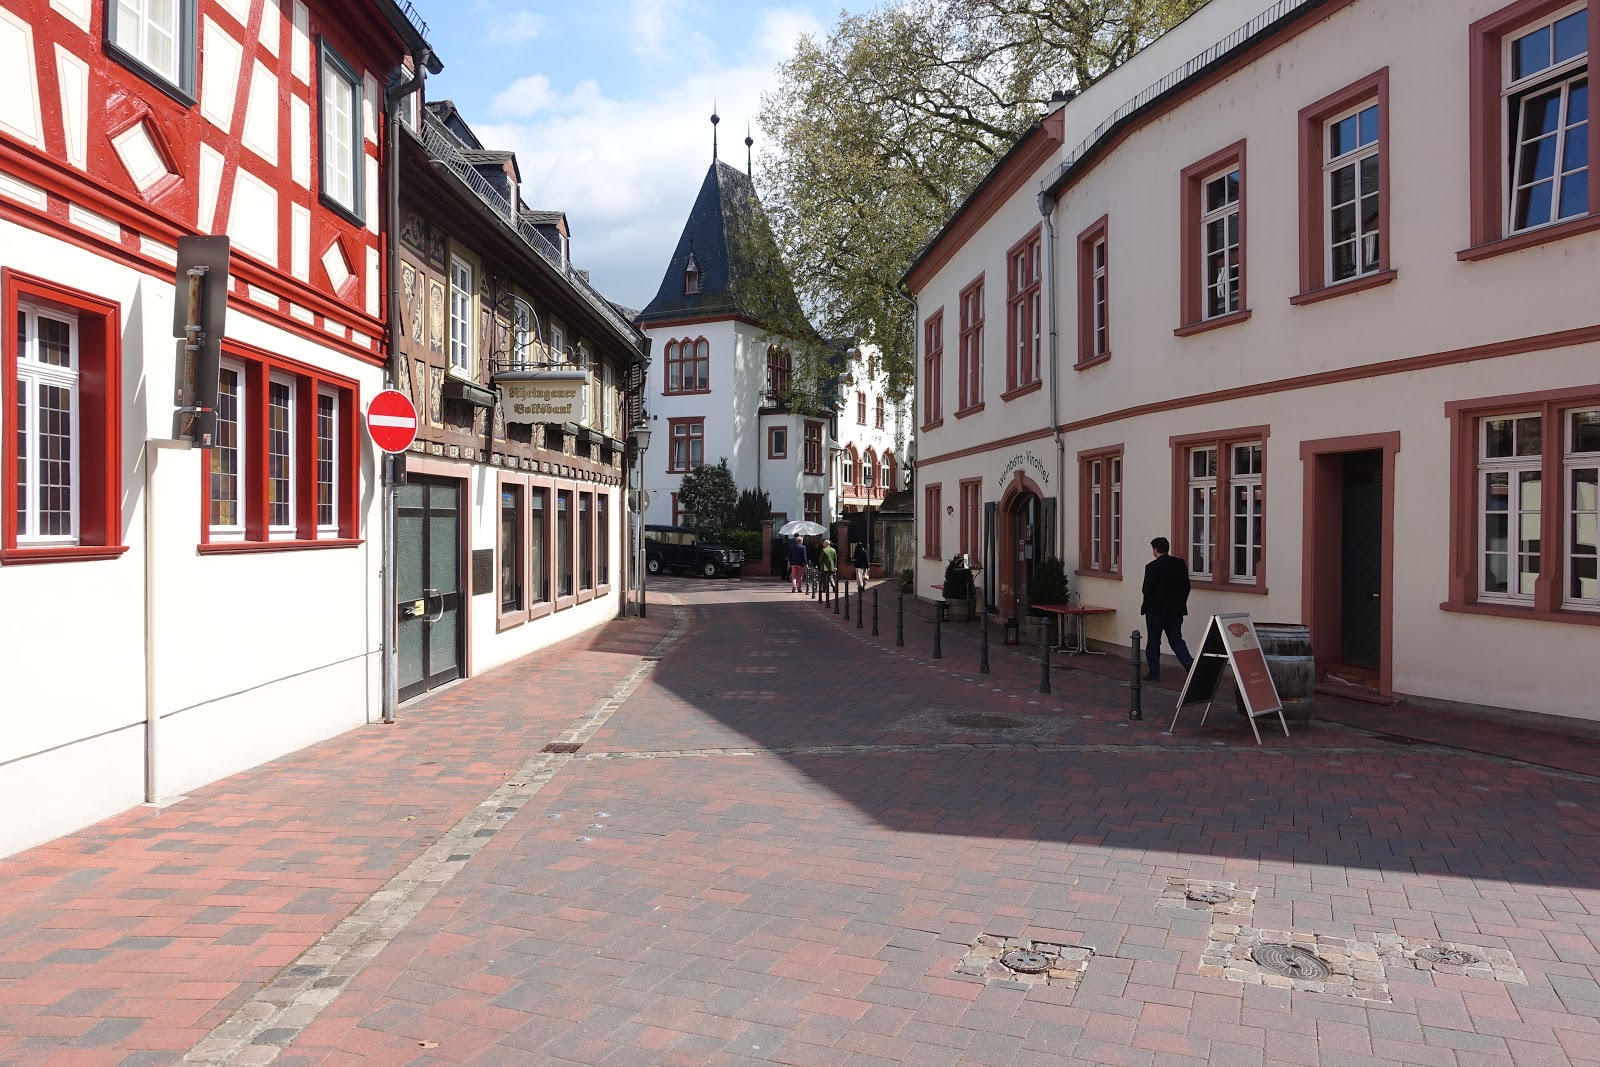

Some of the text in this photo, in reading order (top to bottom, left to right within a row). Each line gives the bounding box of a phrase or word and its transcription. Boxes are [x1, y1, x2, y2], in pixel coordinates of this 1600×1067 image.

[513, 403, 572, 415] Volksbank
[998, 450, 1050, 488] Weinbistro Vinothek
